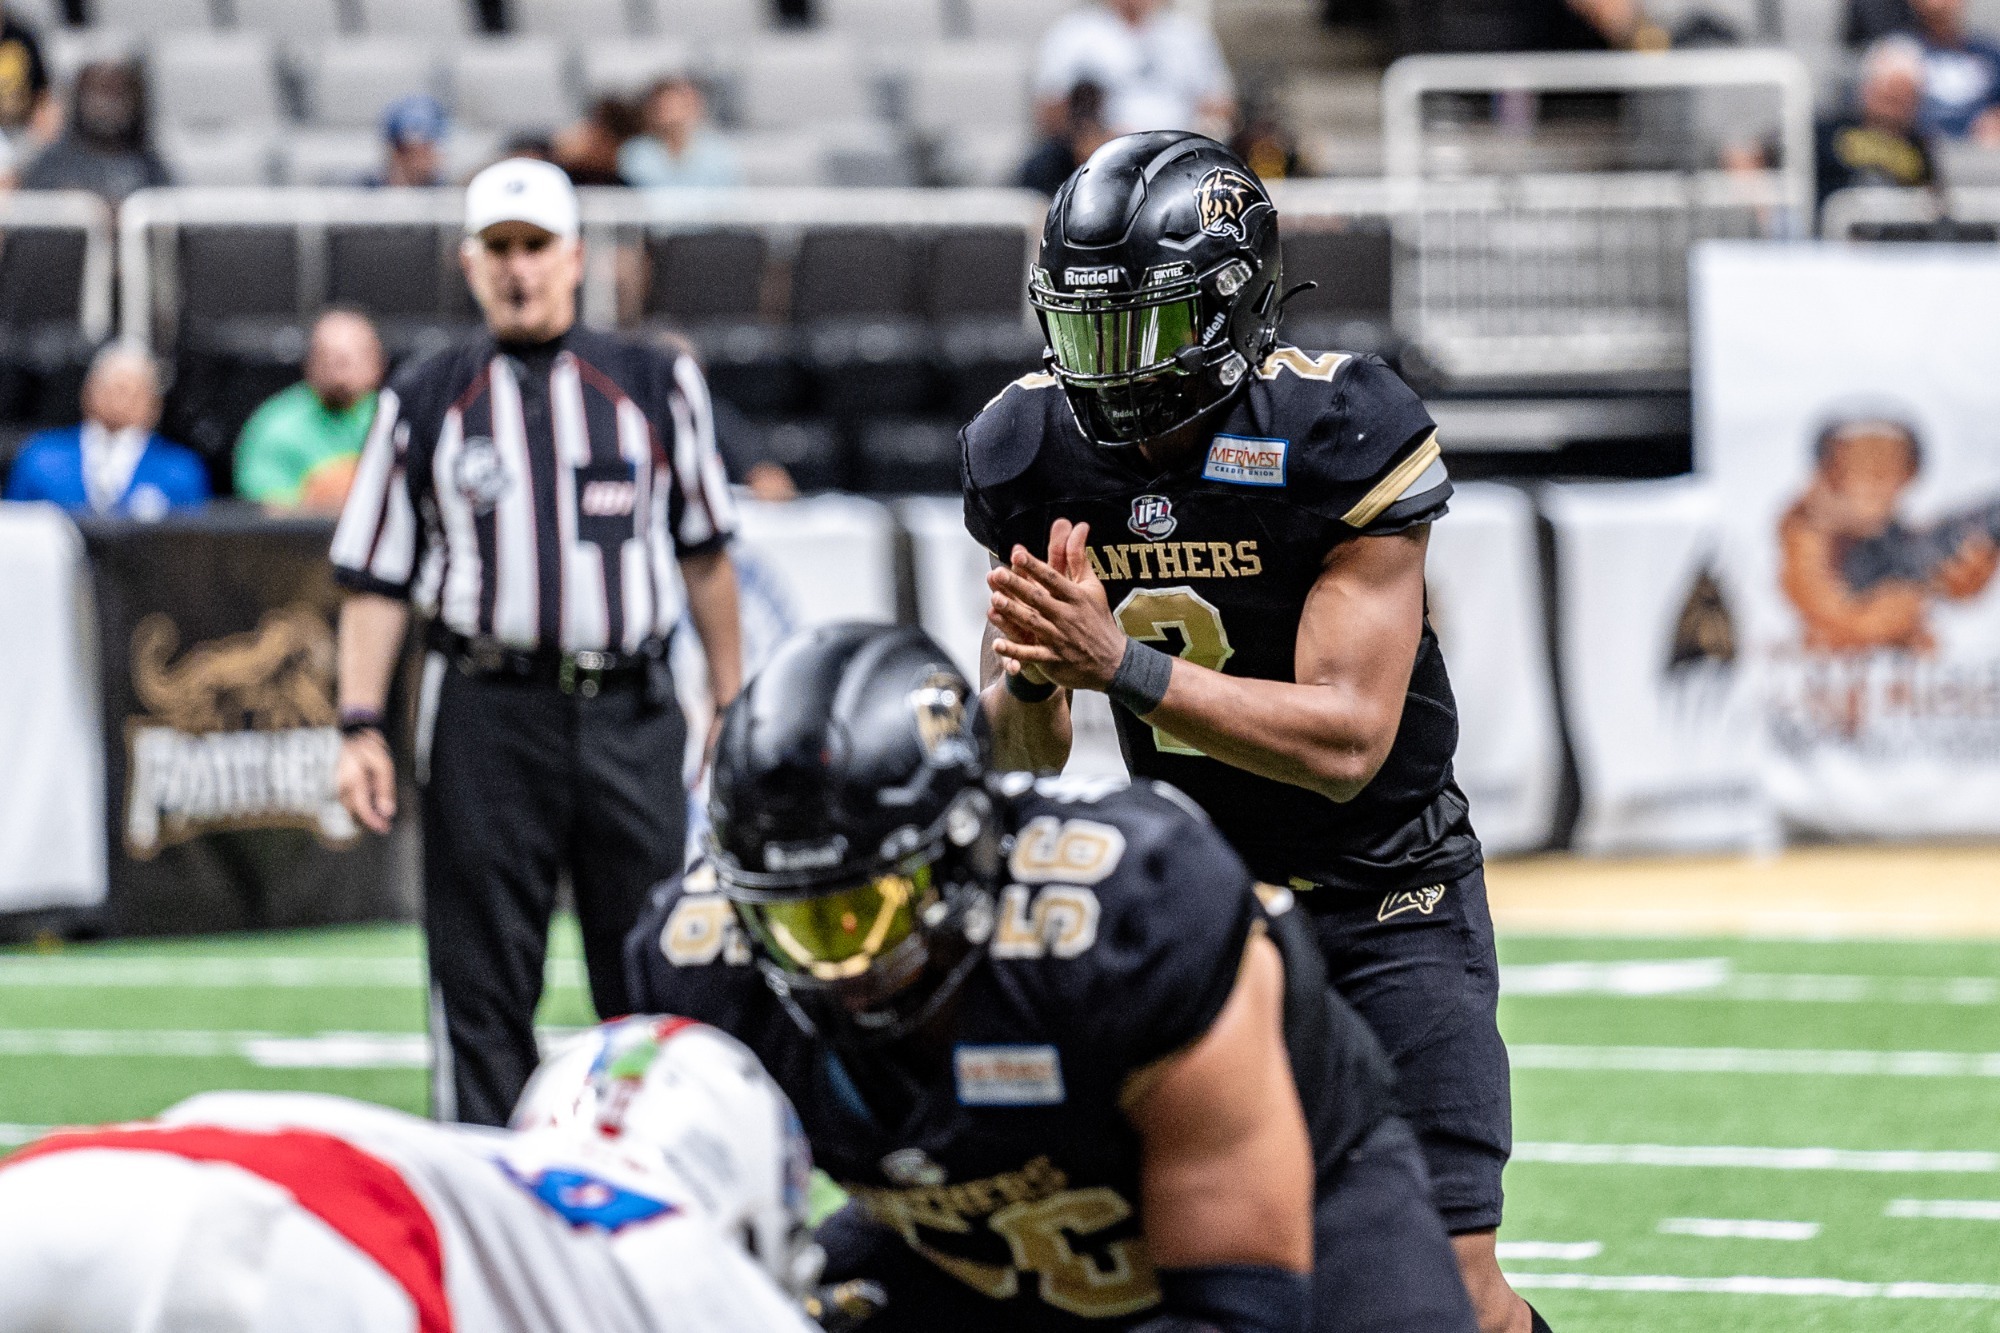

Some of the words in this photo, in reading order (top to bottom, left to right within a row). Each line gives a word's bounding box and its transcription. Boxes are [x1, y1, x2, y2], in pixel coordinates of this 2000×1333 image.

[1064, 269, 1119, 285] Riddell
[1112, 408, 1140, 418] Riddel
[1214, 465, 1244, 475] CREDIT
[1139, 502, 1166, 524] IFL
[1085, 540, 1263, 580] ANTHERS
